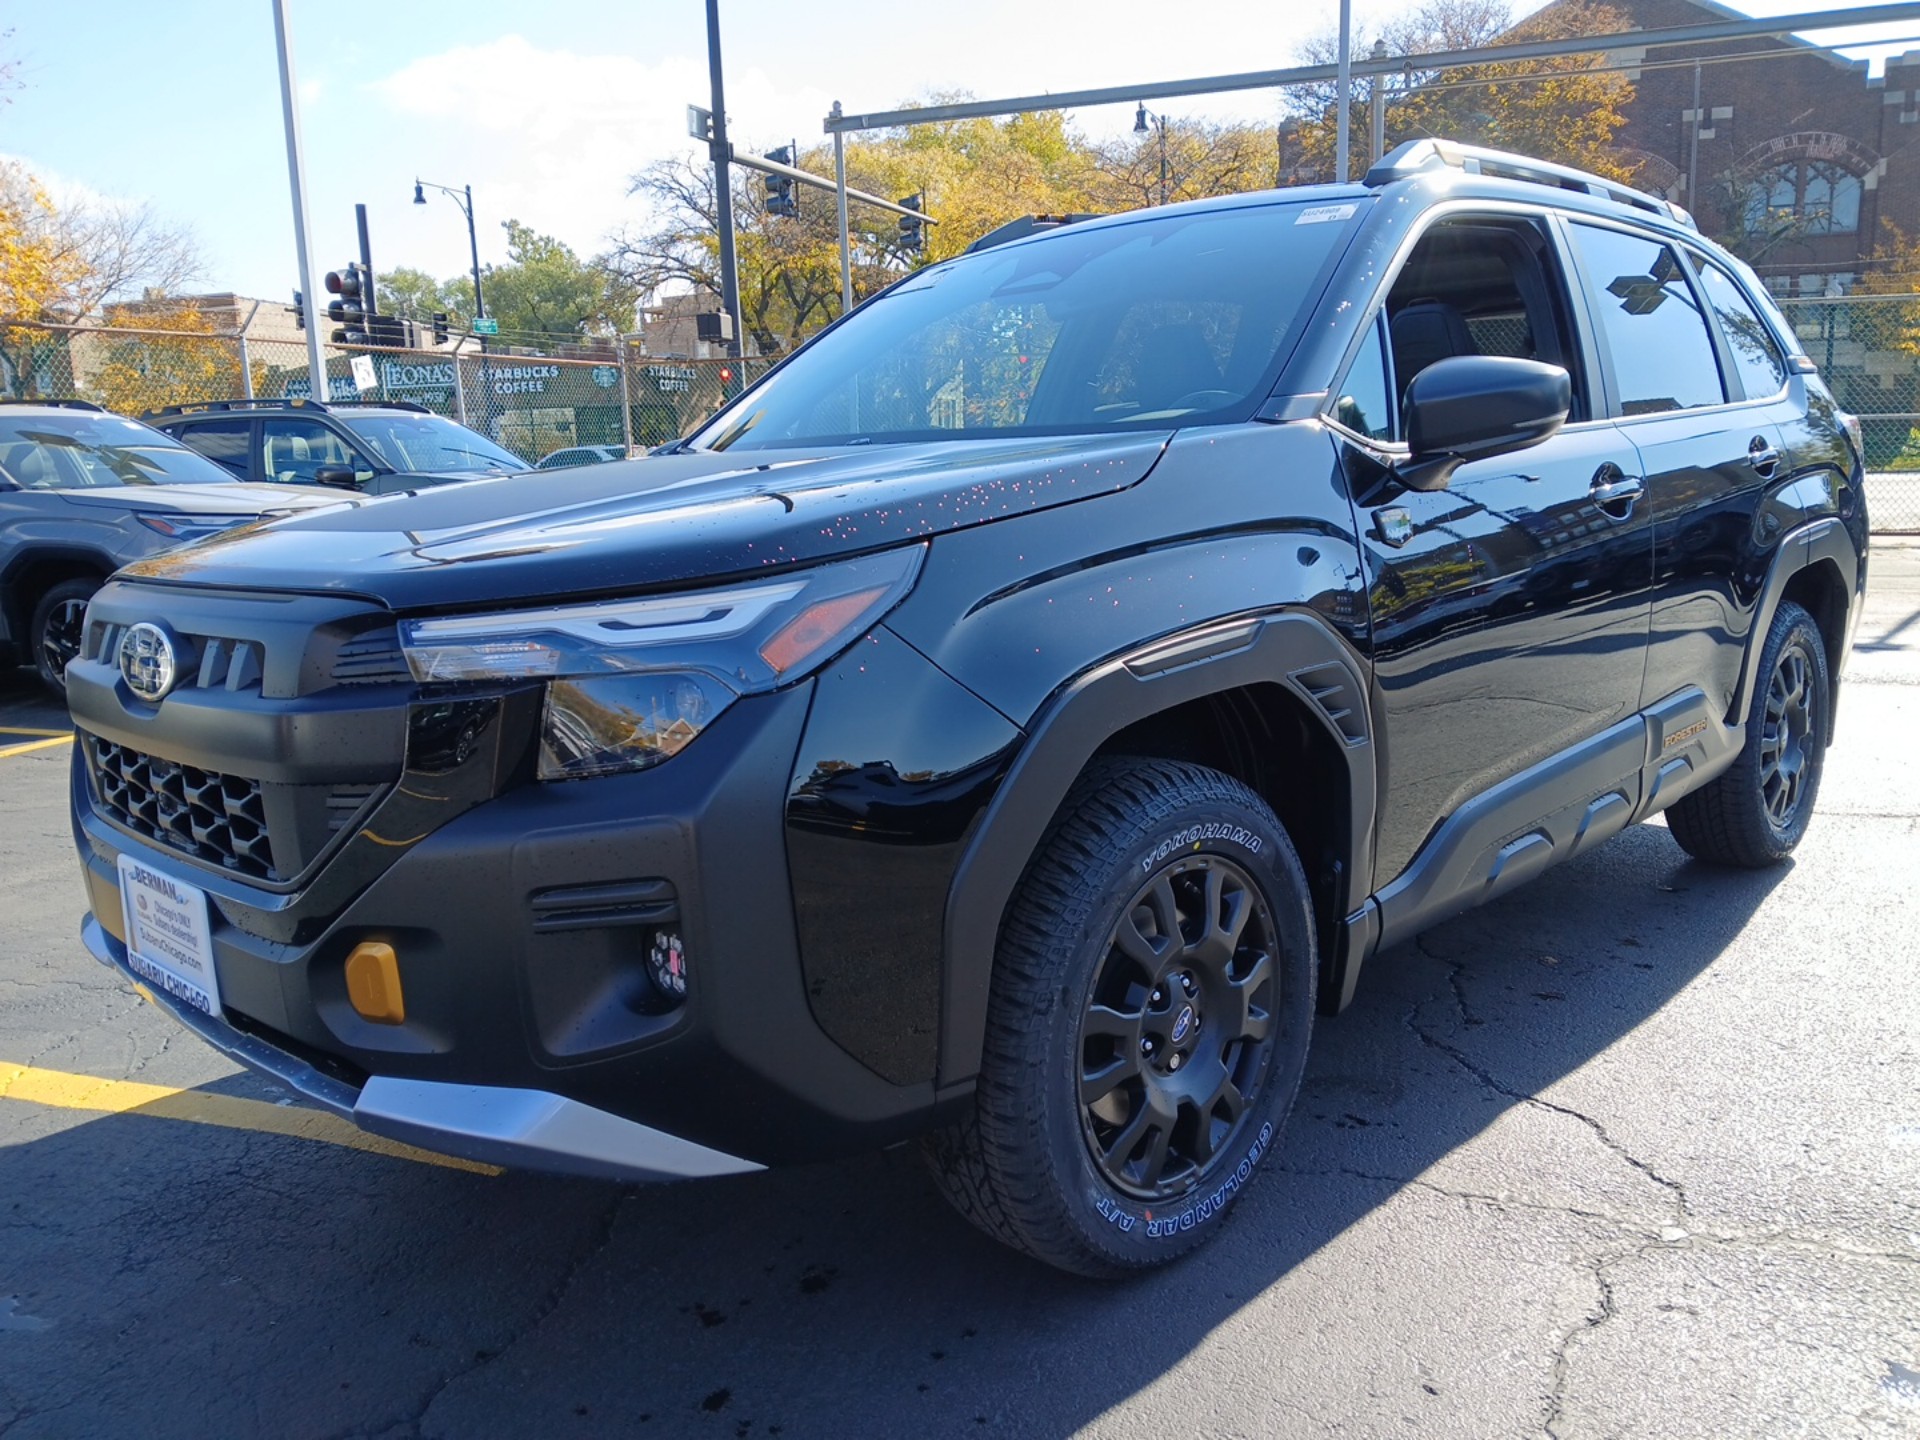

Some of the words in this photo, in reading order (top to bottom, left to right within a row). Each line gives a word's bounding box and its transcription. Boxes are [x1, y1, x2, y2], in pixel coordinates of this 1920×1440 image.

[387, 363, 455, 388] LEONA'S
[478, 366, 559, 381] STARBUCKS
[495, 380, 544, 393] COFFEE
[650, 367, 697, 380] STARBUCKS
[659, 379, 689, 391] COFFEE
[1664, 719, 1707, 748] FORESTER
[1141, 822, 1263, 873] YOKOHAMA
[135, 866, 177, 899] BERMAN
[130, 953, 165, 986] SUBARU
[167, 974, 210, 1014] CHICAGO
[1146, 1121, 1274, 1238] GEOLANDAR
[1095, 1197, 1137, 1233] A/T
